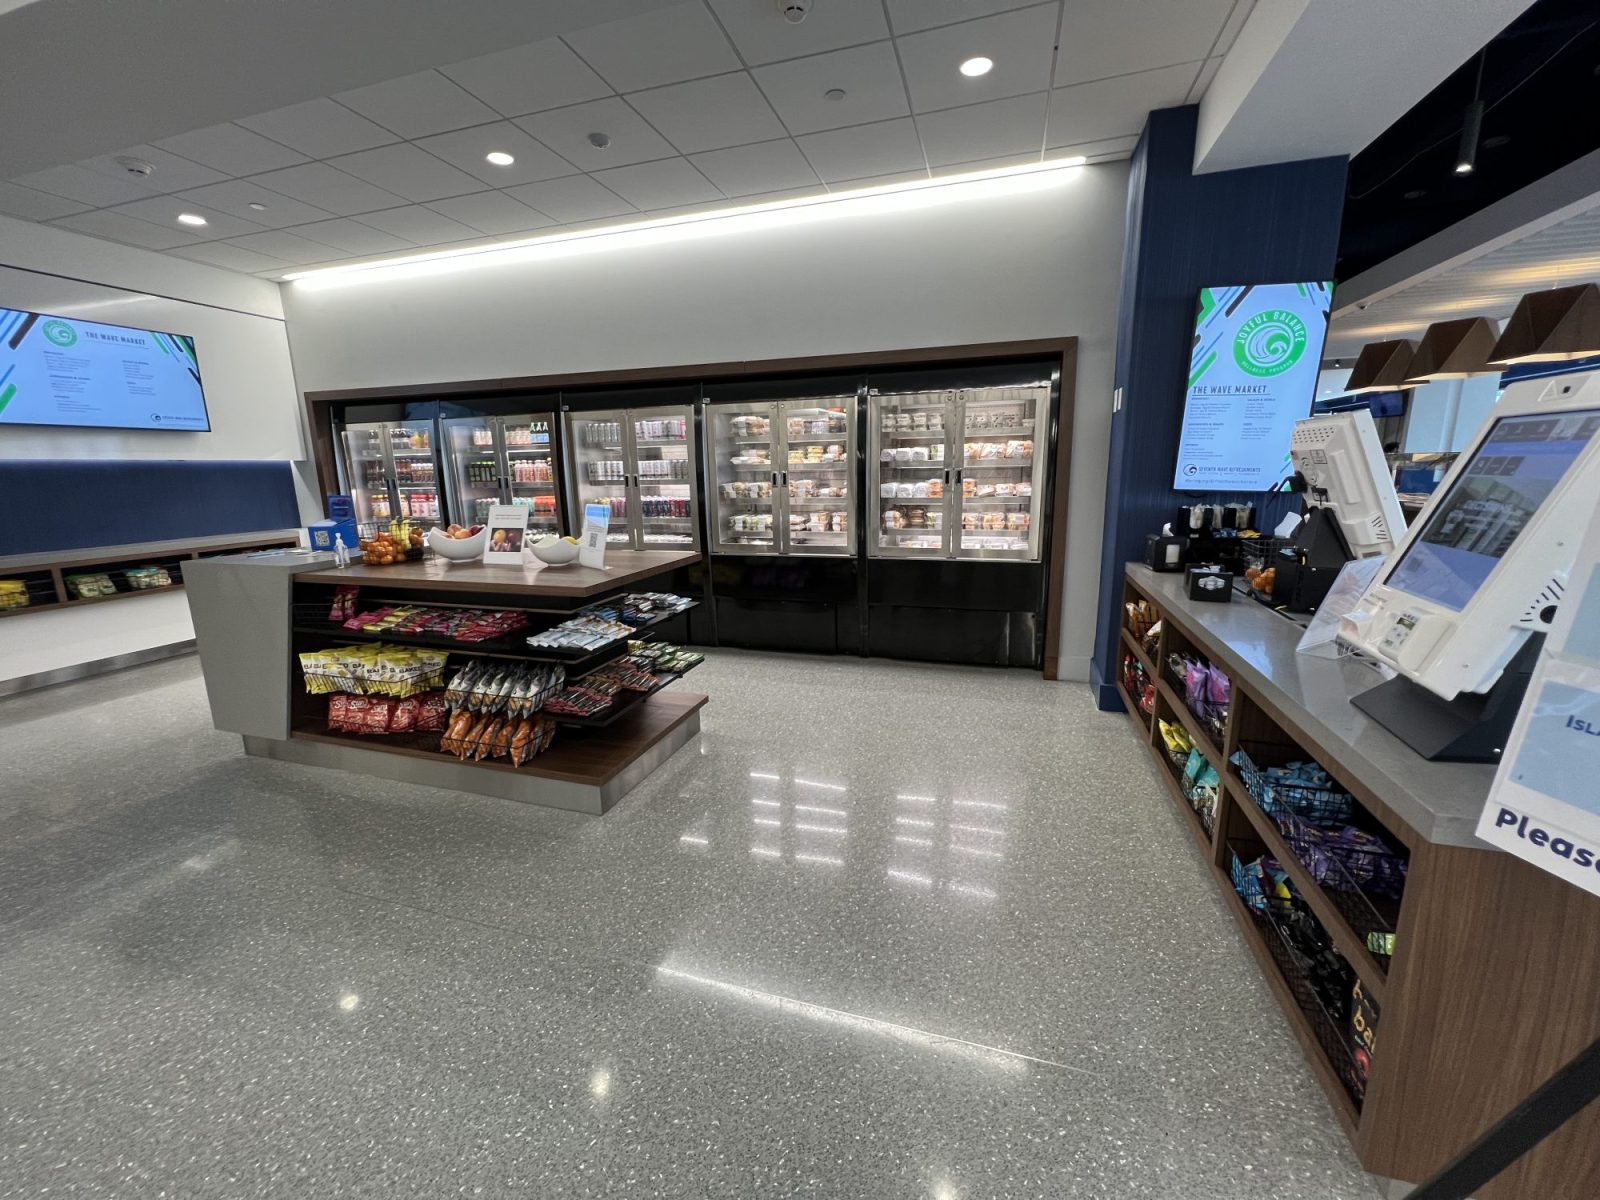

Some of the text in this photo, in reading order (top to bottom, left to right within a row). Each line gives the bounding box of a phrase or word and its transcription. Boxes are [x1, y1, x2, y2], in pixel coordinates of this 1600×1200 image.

[1236, 311, 1305, 344] JOYFUL BALANCE
[86, 331, 146, 345] THE WAVE MARKET
[1193, 385, 1267, 394] THE WAVE MARKET
